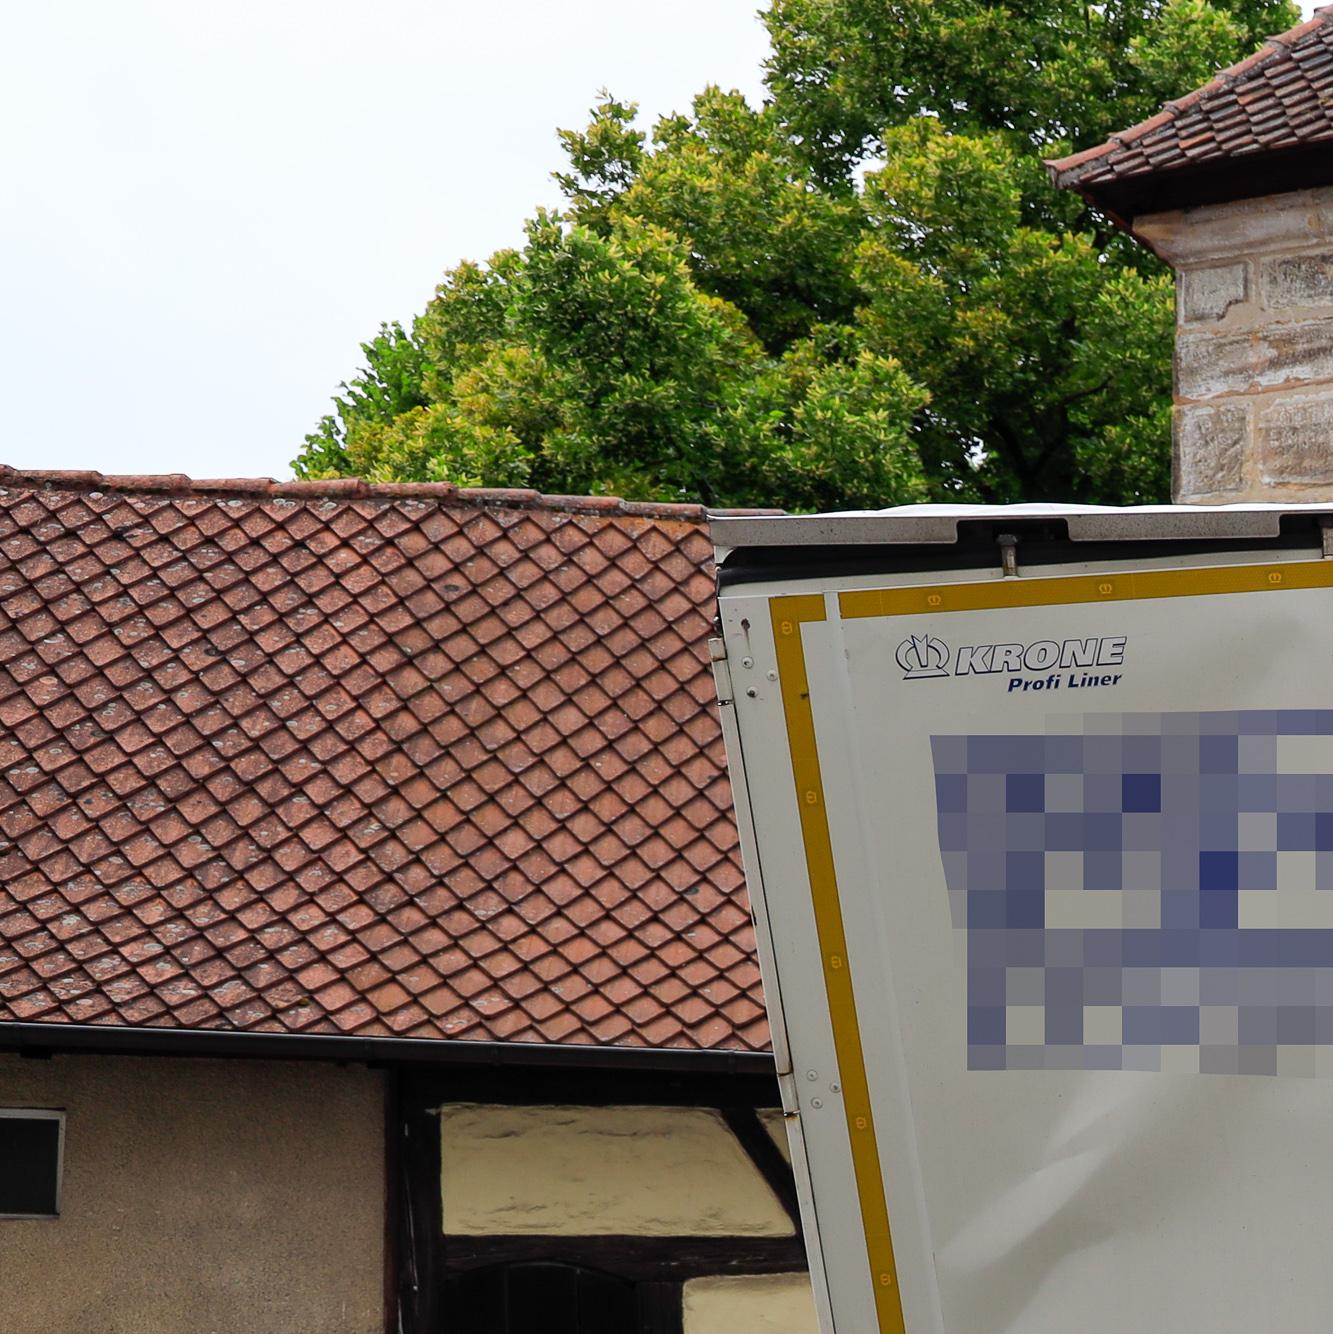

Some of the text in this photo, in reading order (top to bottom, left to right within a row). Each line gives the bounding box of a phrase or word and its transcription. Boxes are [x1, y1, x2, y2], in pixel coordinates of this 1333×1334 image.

[955, 636, 1128, 676] KRONE
[1007, 672, 1122, 692] Profi Liner
